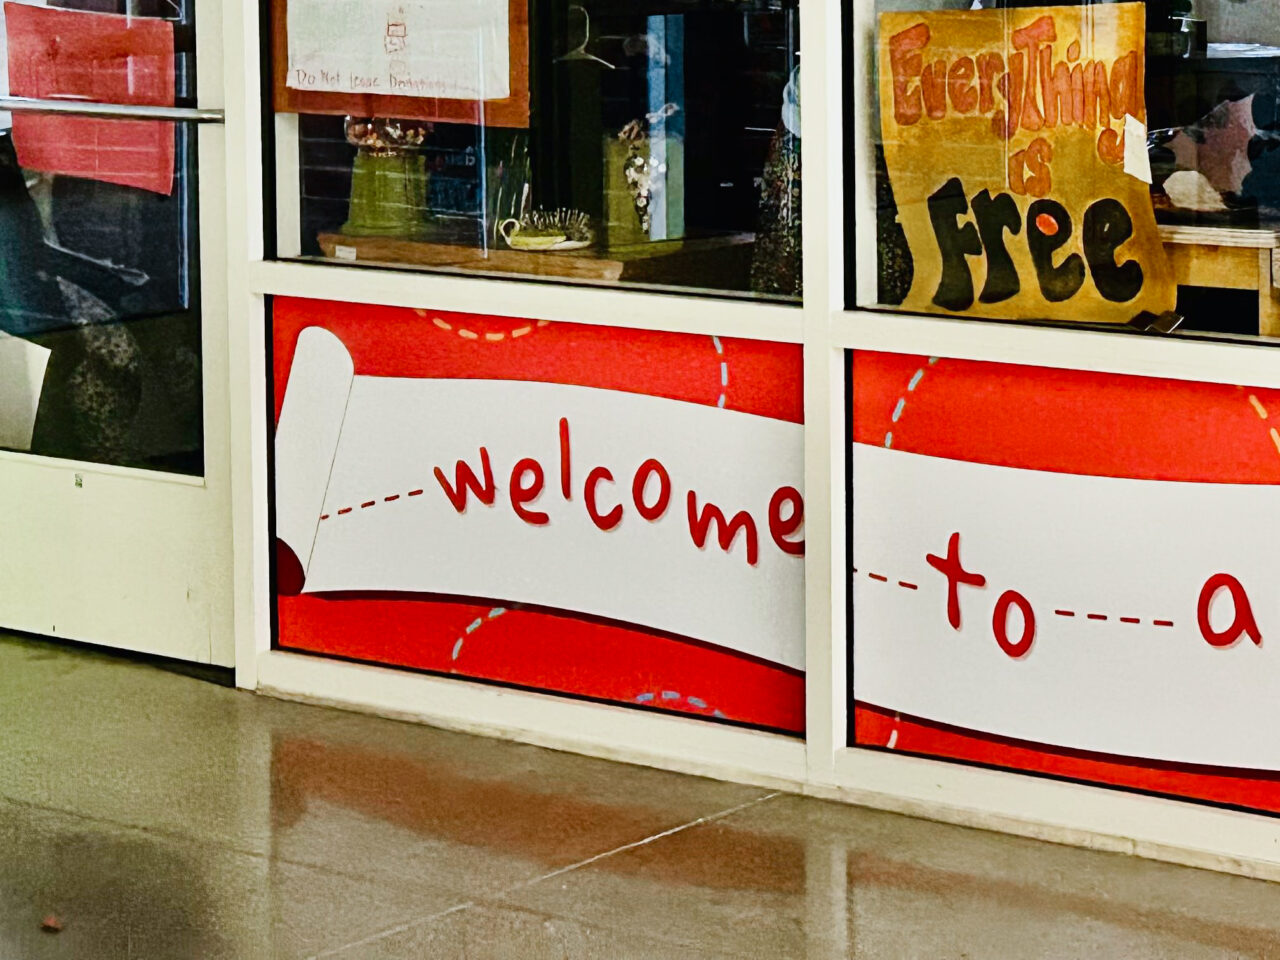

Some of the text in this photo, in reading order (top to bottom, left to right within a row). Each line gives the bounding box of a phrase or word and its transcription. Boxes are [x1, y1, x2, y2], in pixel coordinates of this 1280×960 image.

[1008, 137, 1052, 198] is
[433, 417, 804, 566] welcome
[926, 532, 1036, 657] to
